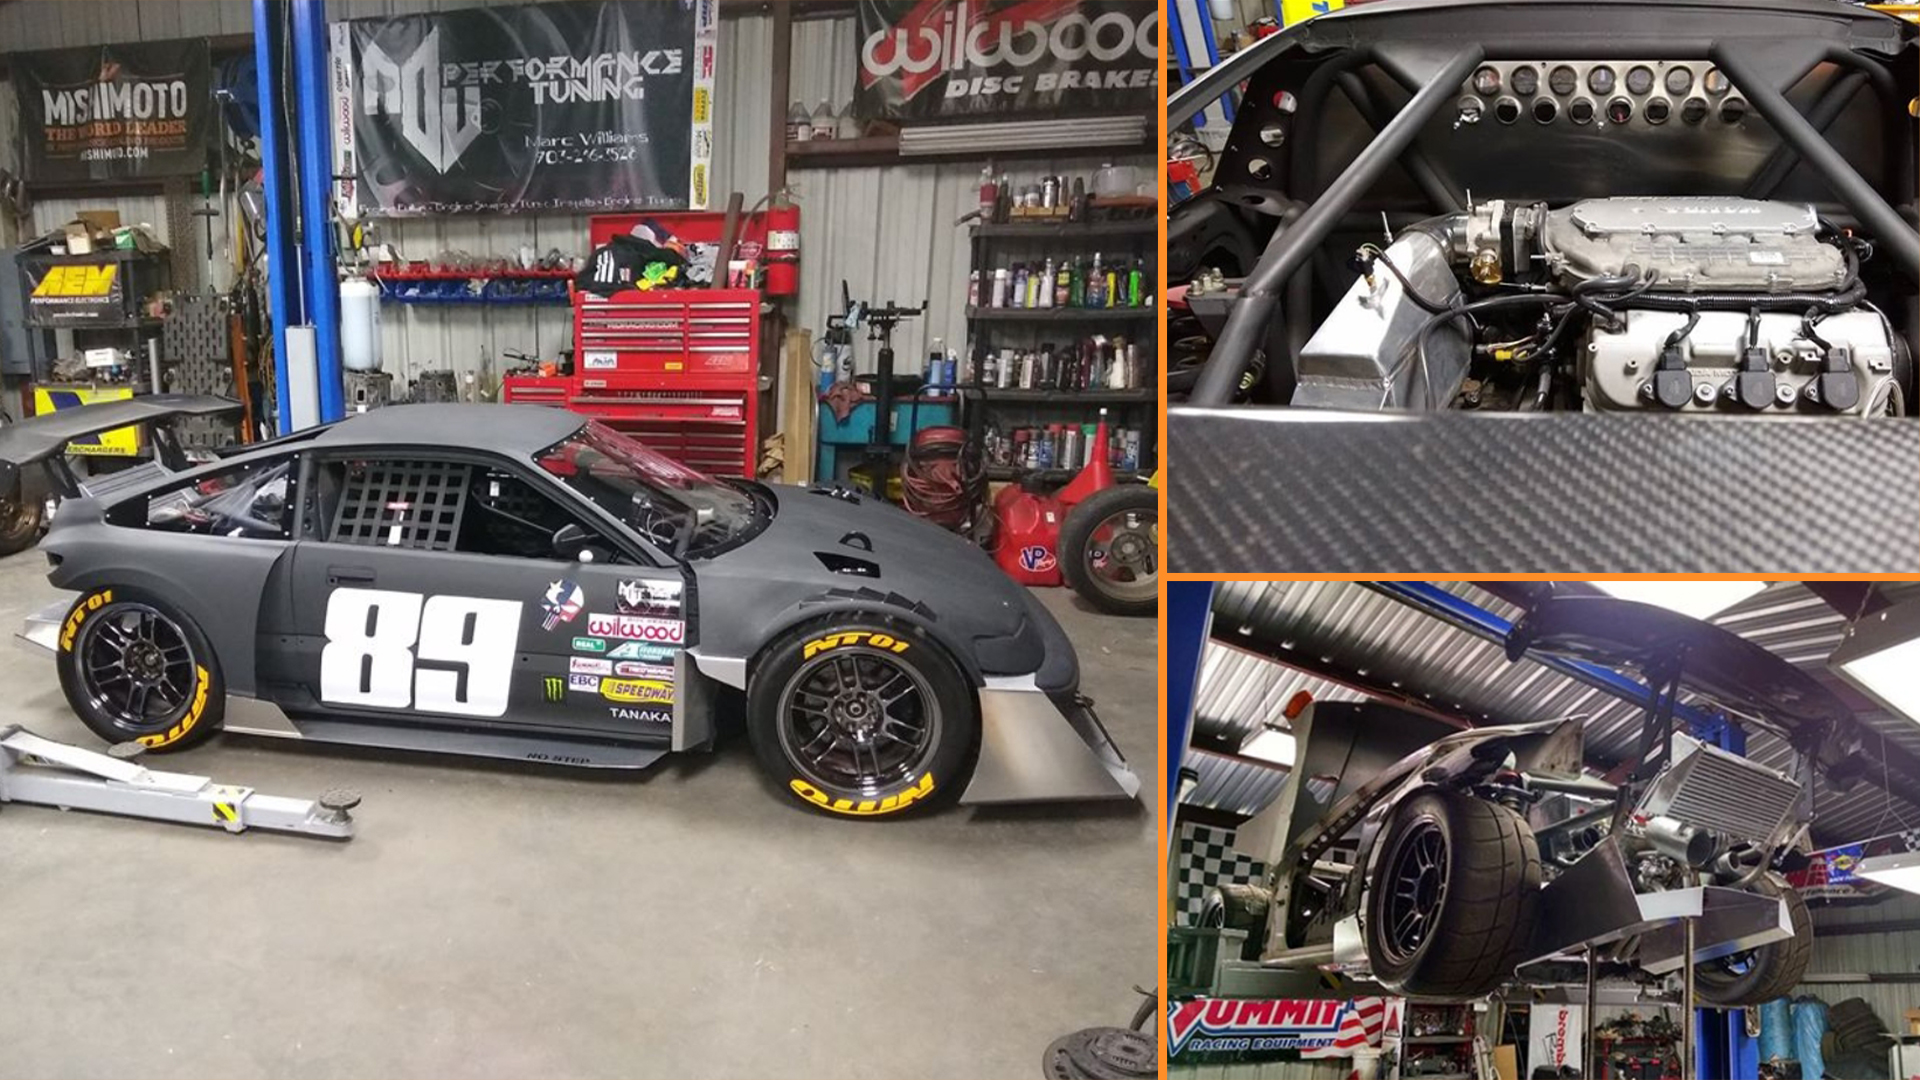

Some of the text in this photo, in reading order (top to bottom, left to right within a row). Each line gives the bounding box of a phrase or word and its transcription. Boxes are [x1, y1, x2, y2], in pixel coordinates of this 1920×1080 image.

[442, 49, 683, 87] PERFORMANCE
[529, 76, 645, 105] TUNING
[945, 75, 1024, 98] DISC
[42, 80, 188, 126] MISHIMOTO
[46, 128, 76, 141] THE
[126, 121, 187, 135] LEADER
[525, 130, 649, 147] Marc Williams
[32, 264, 118, 296] AEM
[1023, 547, 1046, 570] VP
[60, 590, 112, 652] NT01
[590, 617, 683, 642] wilwood
[320, 587, 524, 717] 89
[803, 630, 909, 661] NT01
[571, 674, 598, 687] EBC
[615, 683, 675, 700] SPEEDWAY
[610, 707, 672, 722] TANAKA
[789, 771, 935, 816] NITTO
[1189, 1038, 1336, 1051] RACING EQUIPMENT
